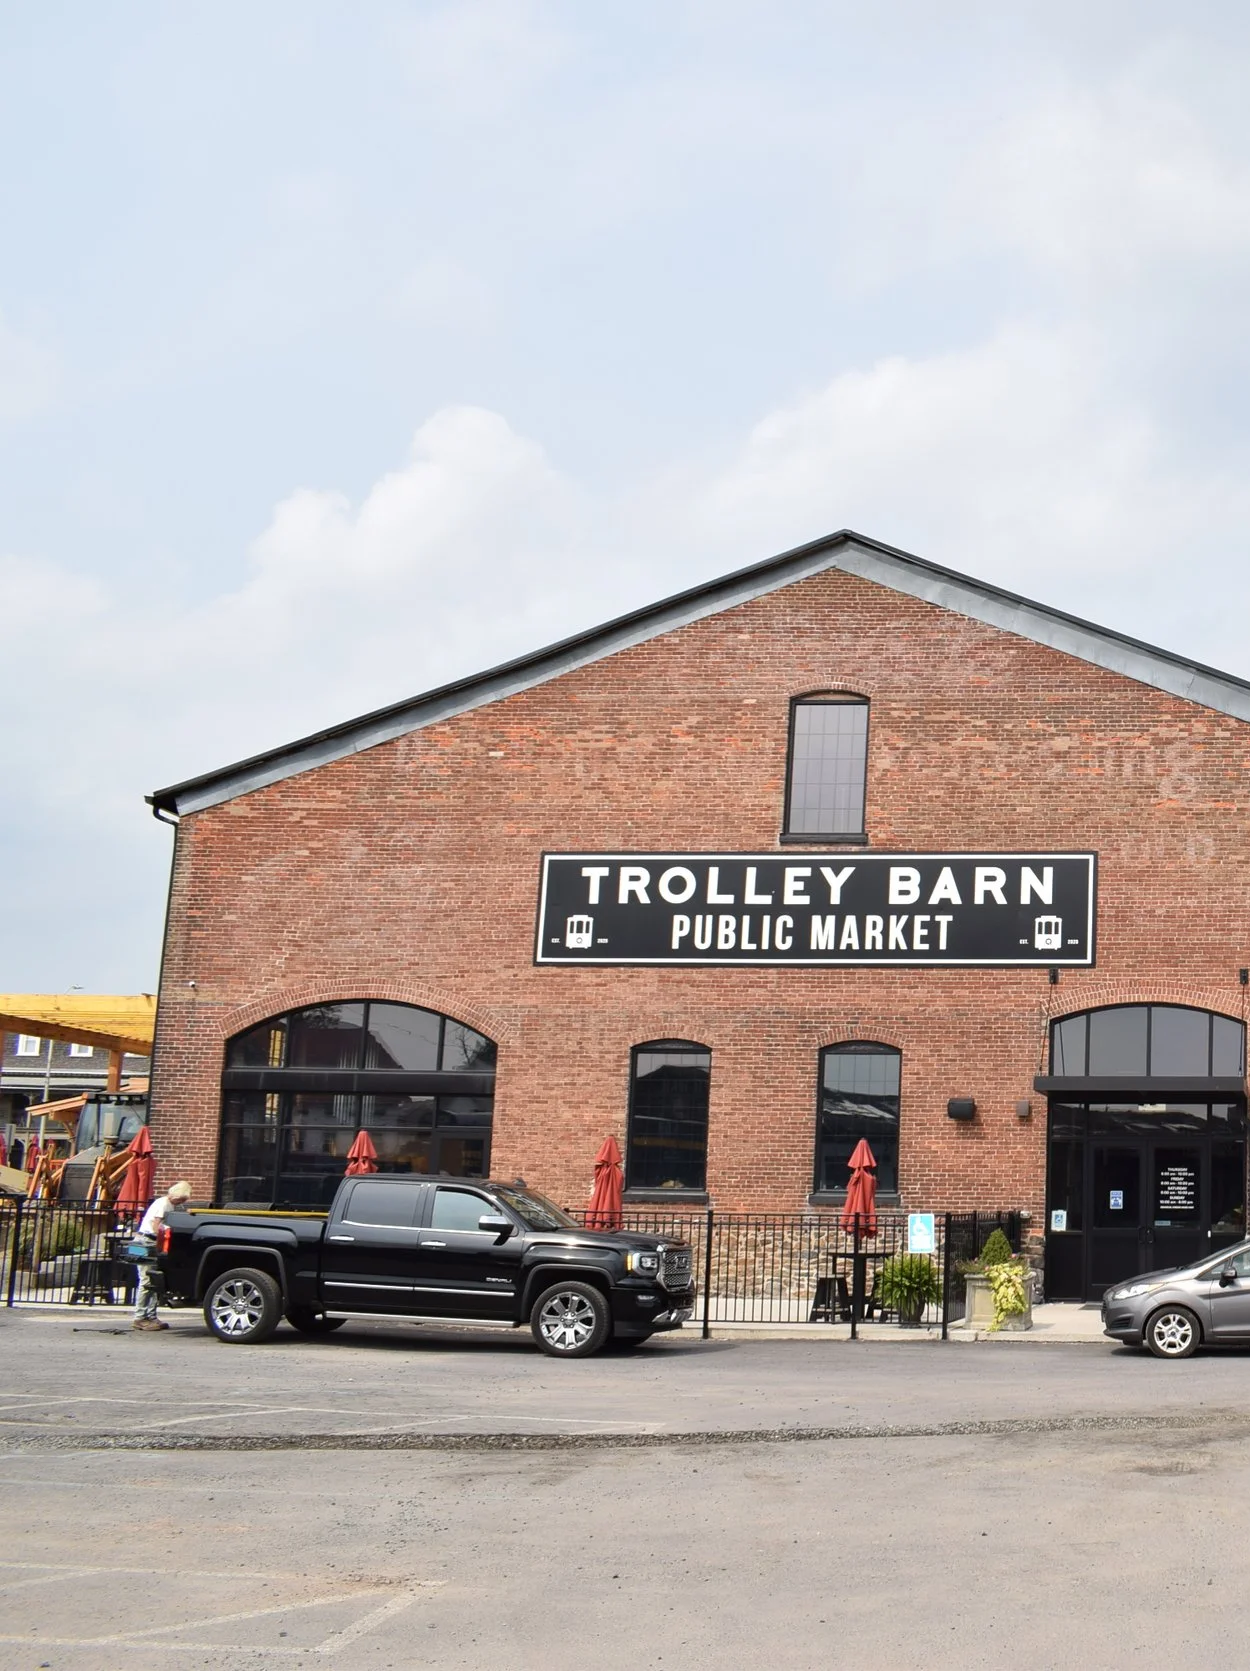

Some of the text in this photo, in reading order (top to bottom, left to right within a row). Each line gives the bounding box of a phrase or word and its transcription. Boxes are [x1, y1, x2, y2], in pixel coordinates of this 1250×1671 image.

[582, 866, 1054, 905] TROLLEY BARN
[672, 914, 954, 950] PUBLIC MARKET
